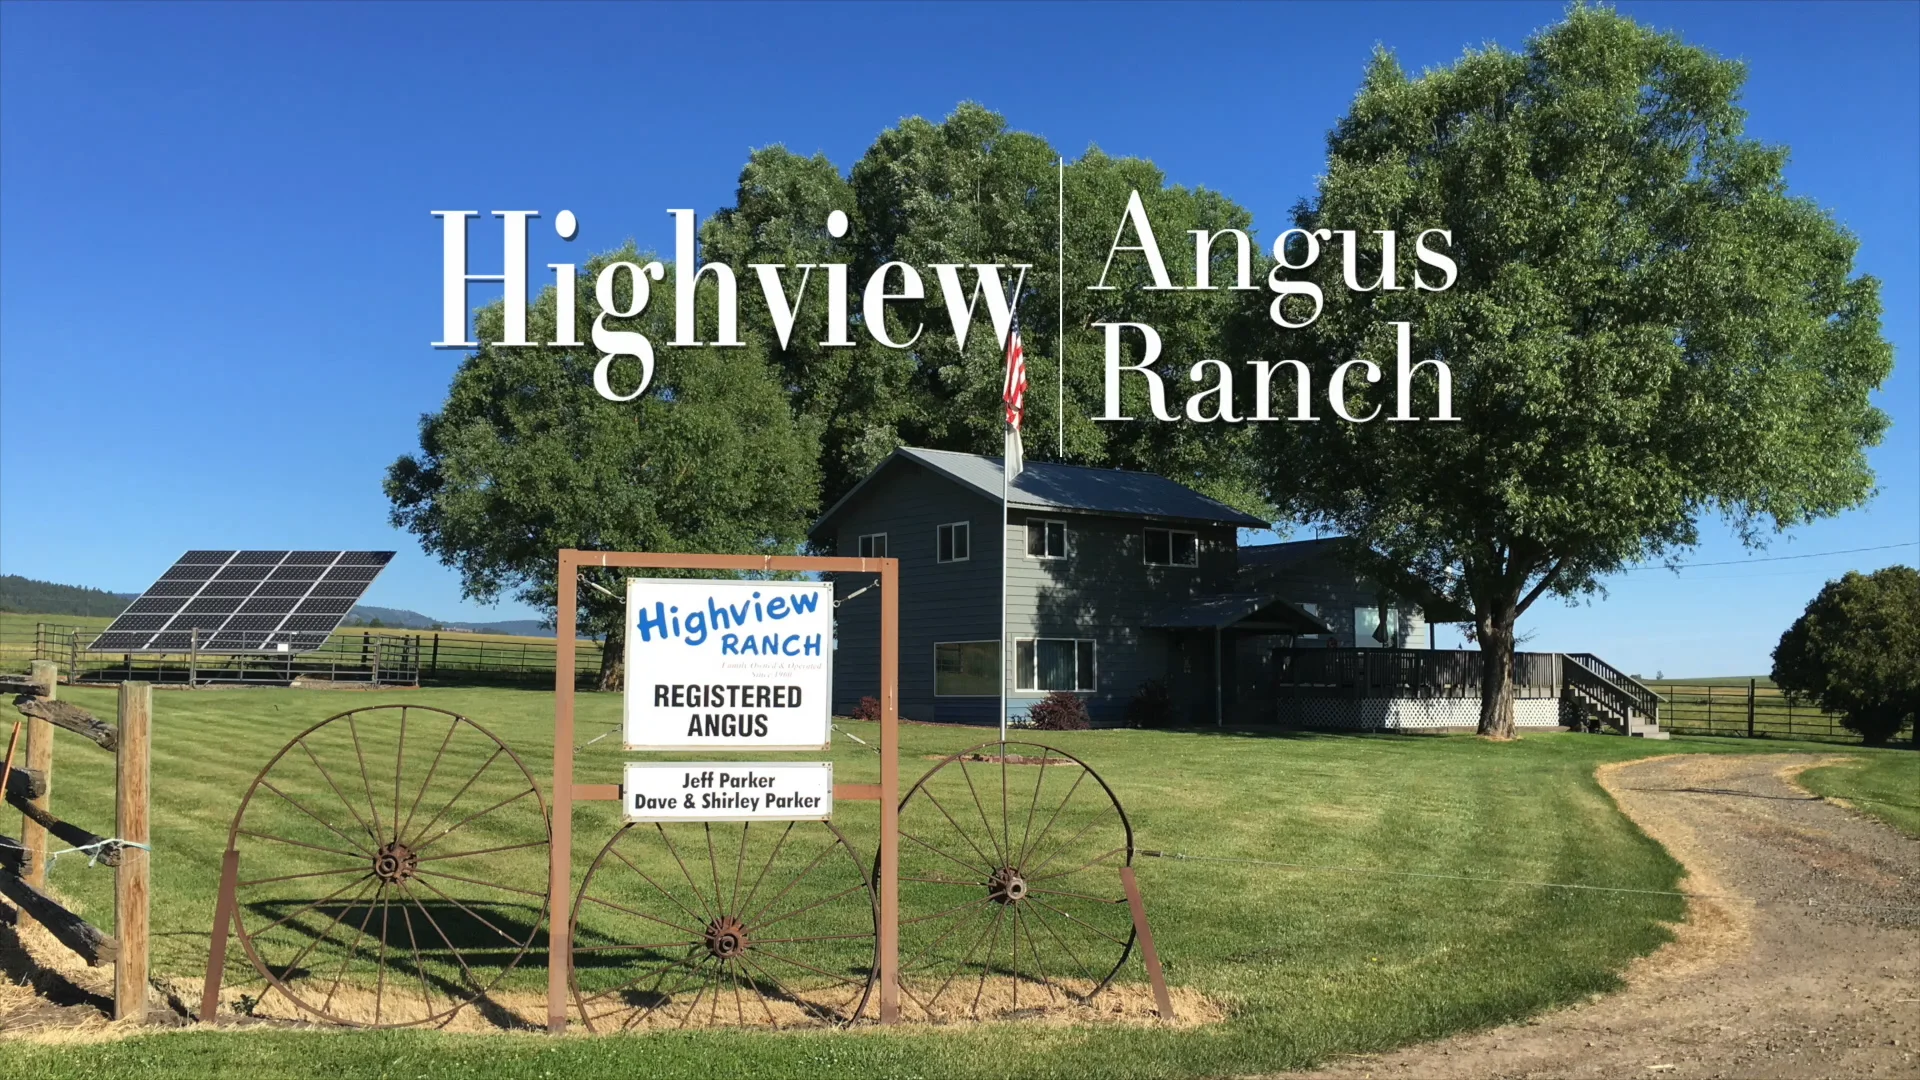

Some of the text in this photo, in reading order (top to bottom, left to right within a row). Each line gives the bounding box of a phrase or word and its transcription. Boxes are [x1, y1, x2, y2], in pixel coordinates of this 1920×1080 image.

[637, 591, 819, 646] Highview
[721, 633, 822, 656] RANCH
[654, 684, 802, 708] REGISTERED
[687, 714, 768, 737] ANGUS
[682, 771, 776, 789] Jeff Parker
[635, 791, 821, 813] Dave & Shirley Parker
